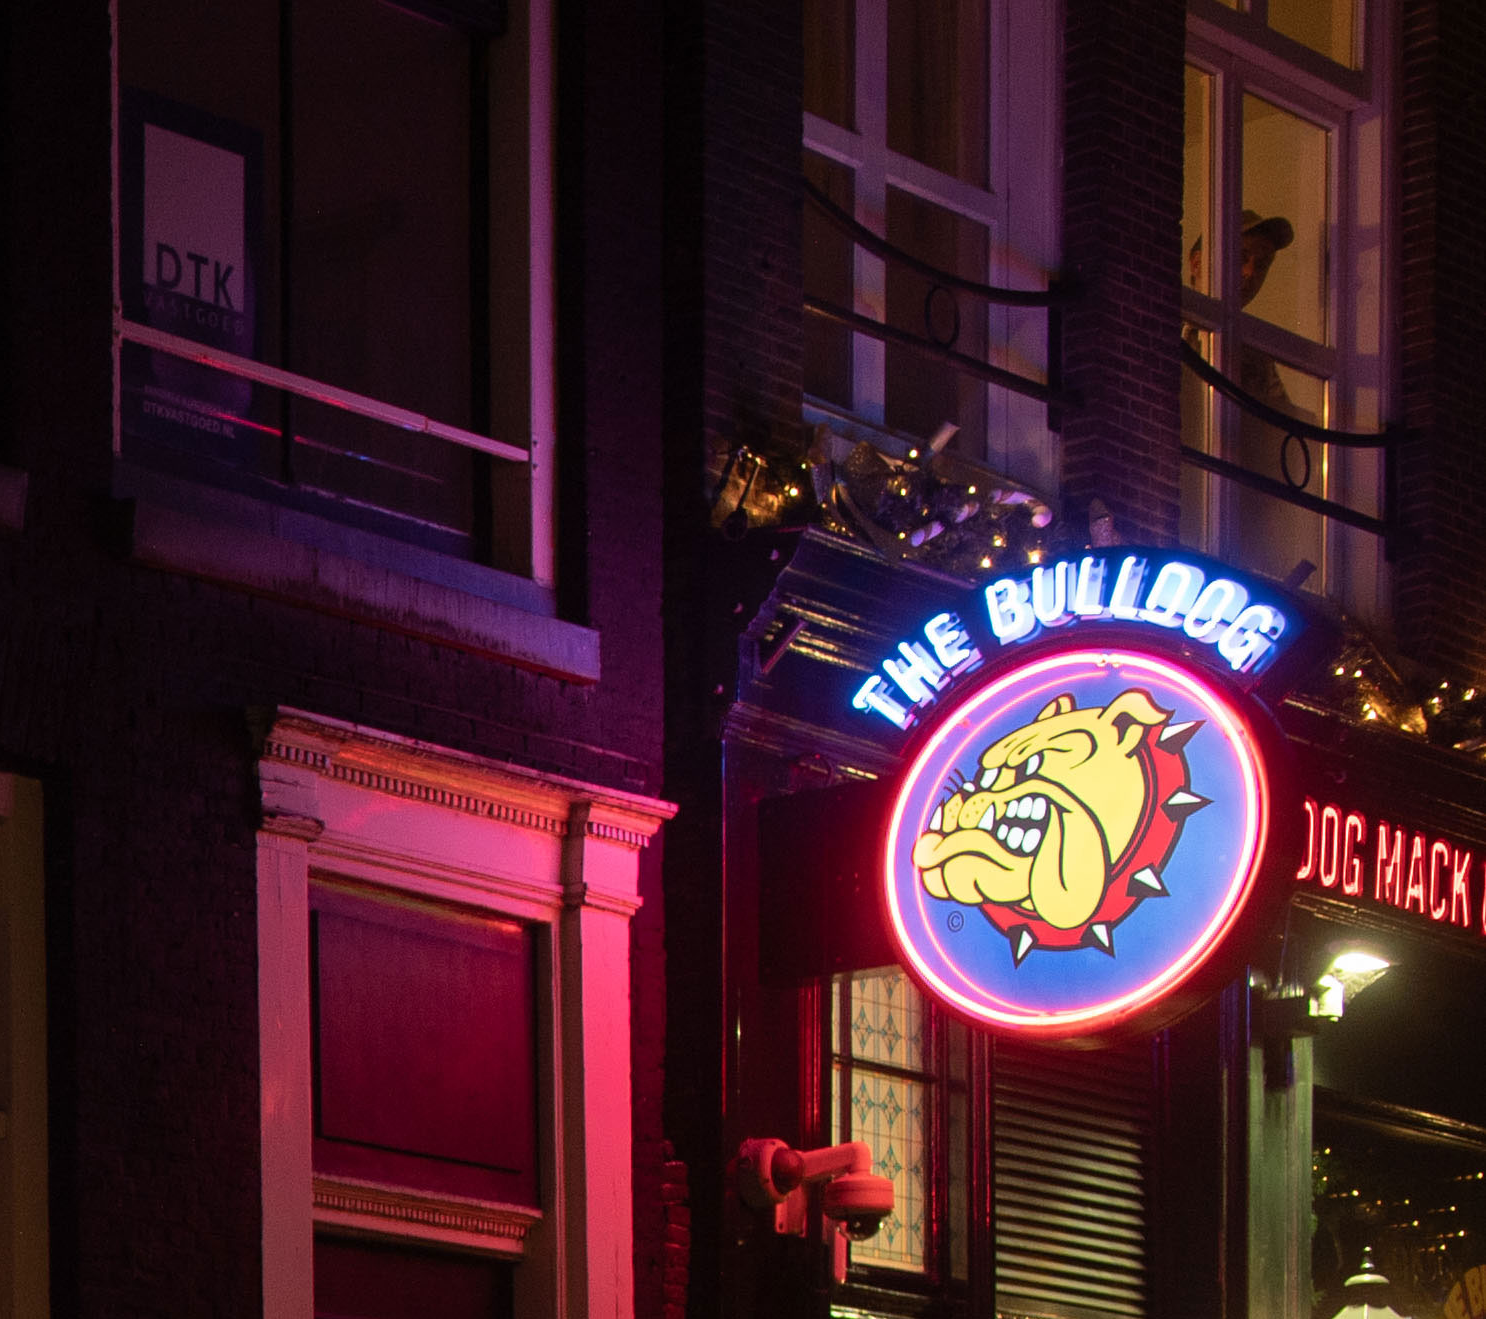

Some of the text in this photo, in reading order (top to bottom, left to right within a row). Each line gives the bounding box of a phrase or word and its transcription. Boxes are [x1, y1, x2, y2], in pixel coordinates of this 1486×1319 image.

[156, 242, 234, 308] DTK
[851, 554, 1287, 730] THE BULLDOG
[1374, 820, 1472, 929] MACK
